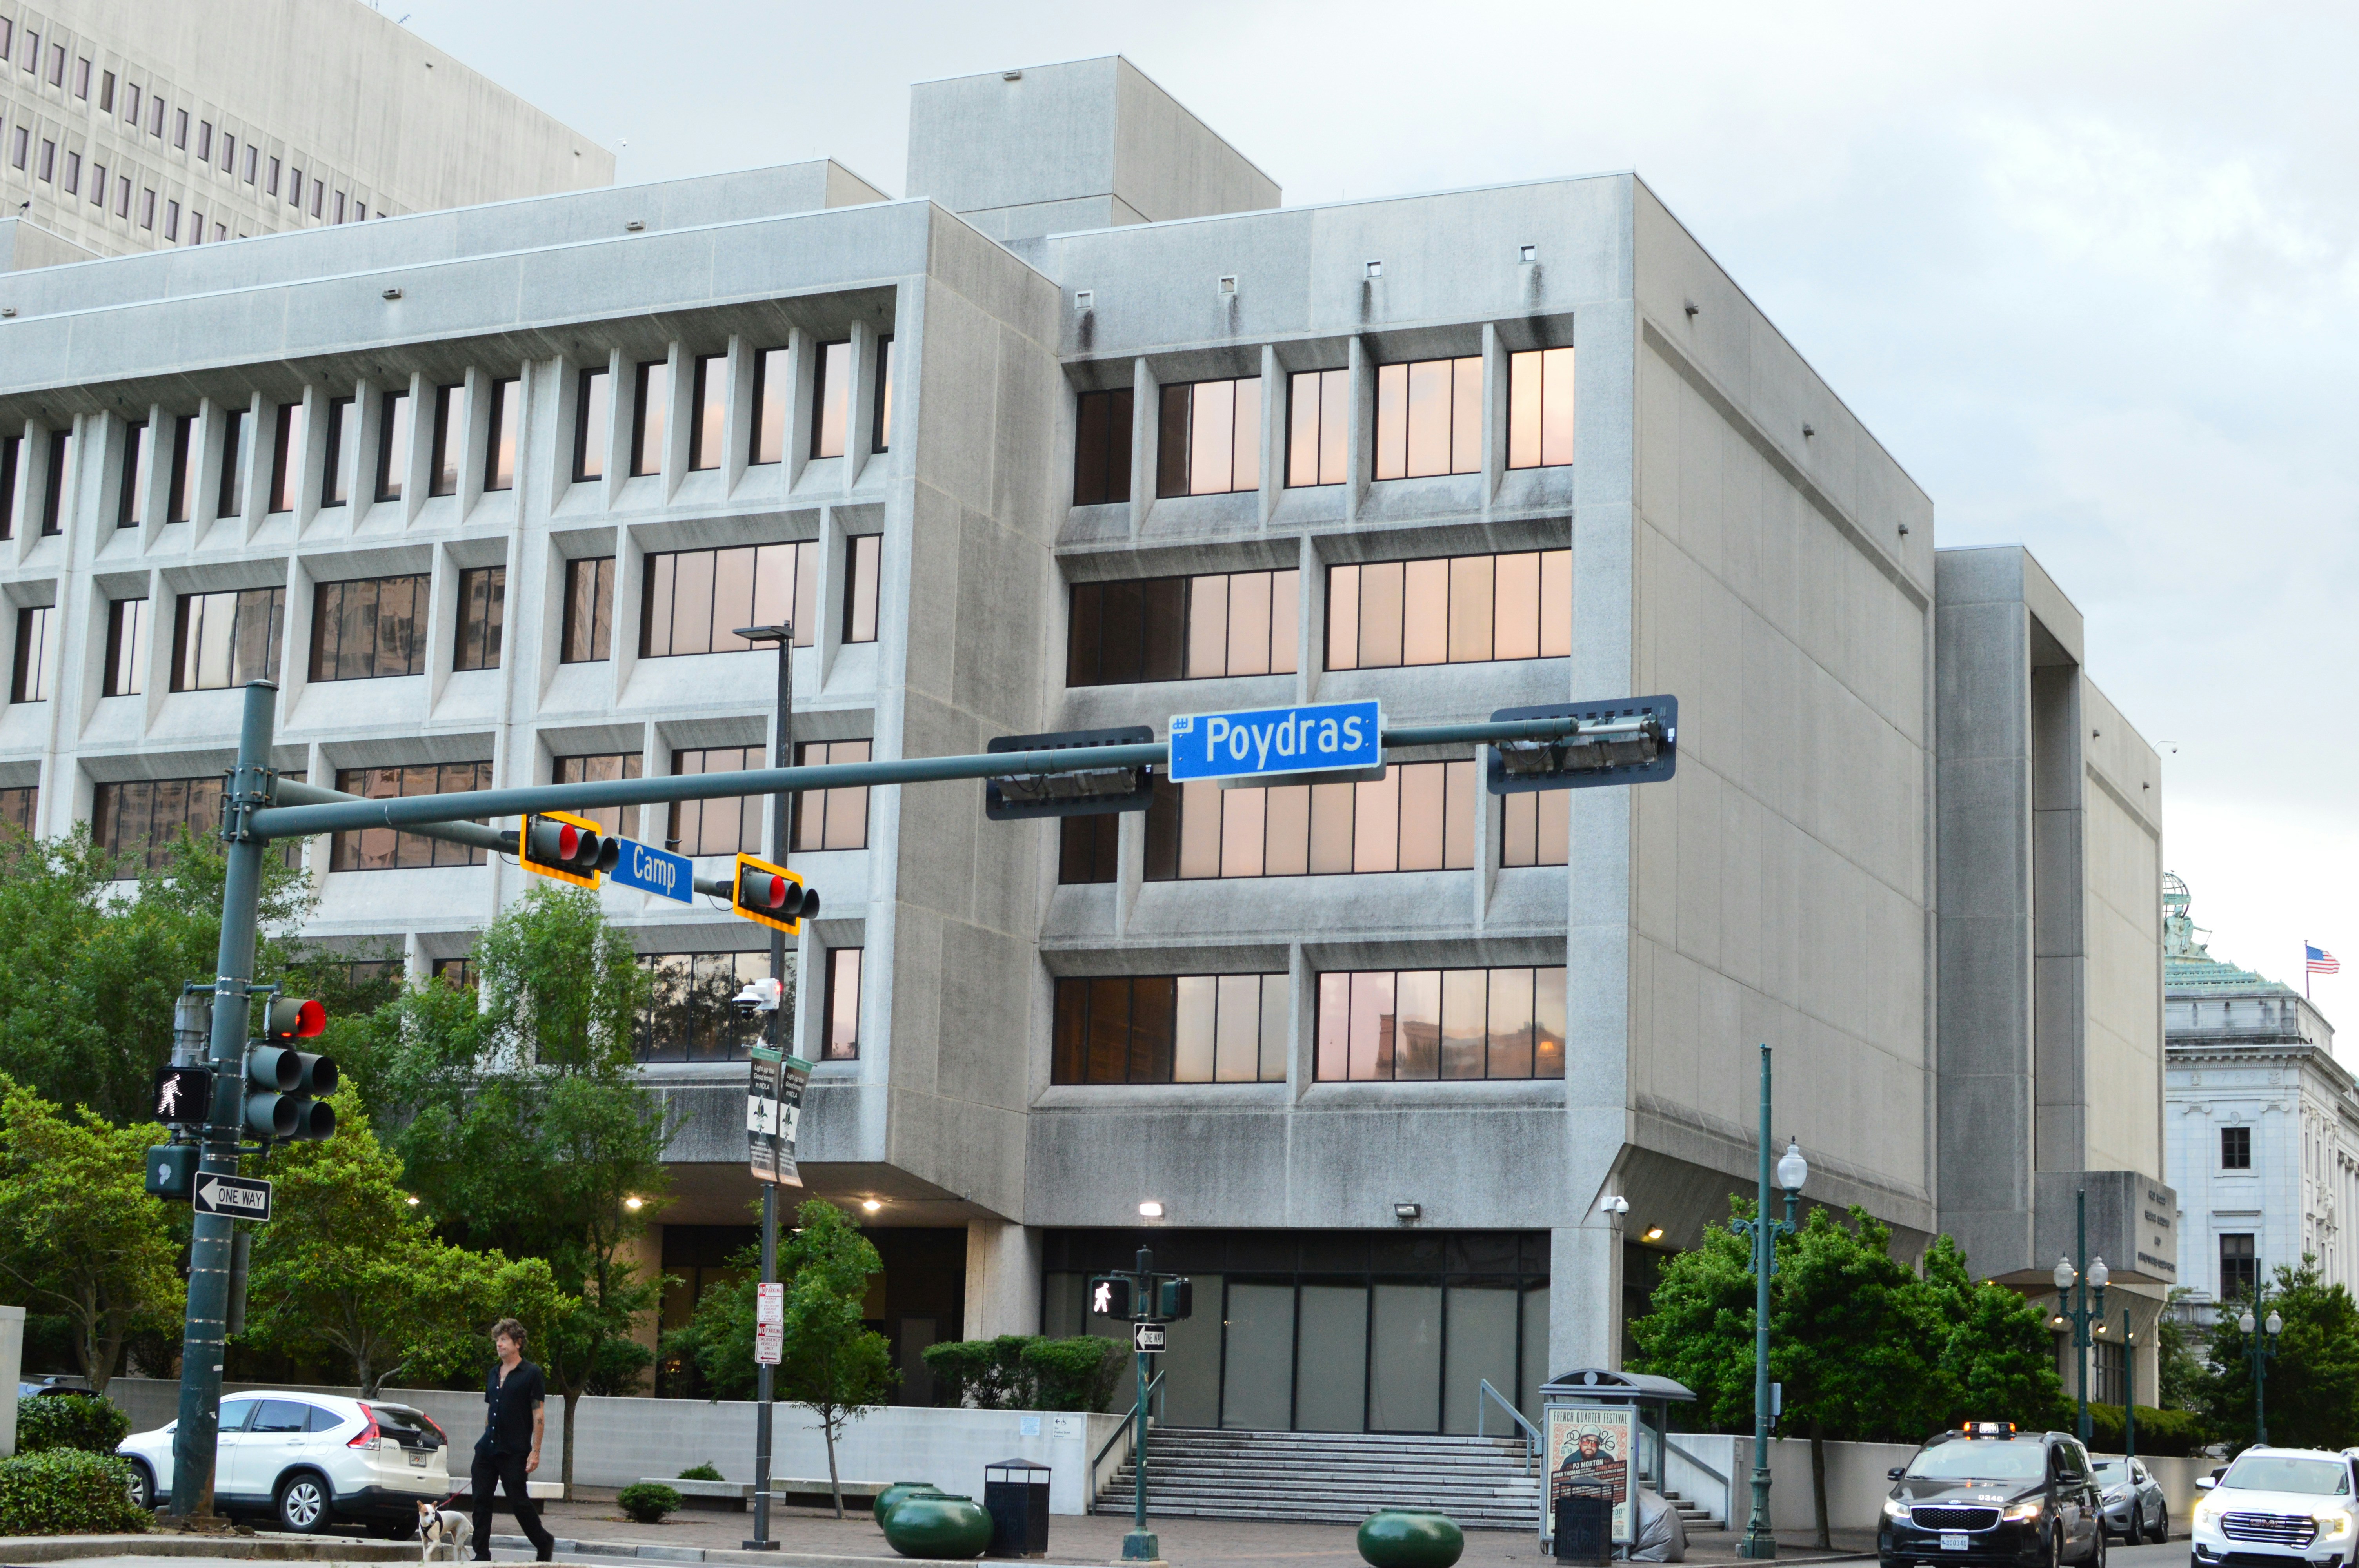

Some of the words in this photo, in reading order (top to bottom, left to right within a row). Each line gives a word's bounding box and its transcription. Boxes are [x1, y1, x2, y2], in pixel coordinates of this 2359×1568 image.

[1207, 711, 1363, 770] Poydras
[633, 845, 676, 895] Camp
[754, 1064, 763, 1073] Light
[218, 1188, 238, 1205] ONE
[242, 1191, 264, 1207] WAY
[759, 1286, 765, 1294] NO
[1144, 1333, 1153, 1343] ONE
[1154, 1333, 1163, 1343] WAY
[1554, 1411, 1574, 1422] FRENCH
[1576, 1412, 1601, 1423] QUARTER
[1603, 1413, 1627, 1424] FESTIVAL
[1581, 1459, 1603, 1468] MORTON
[2250, 1519, 2286, 1528] GMC
